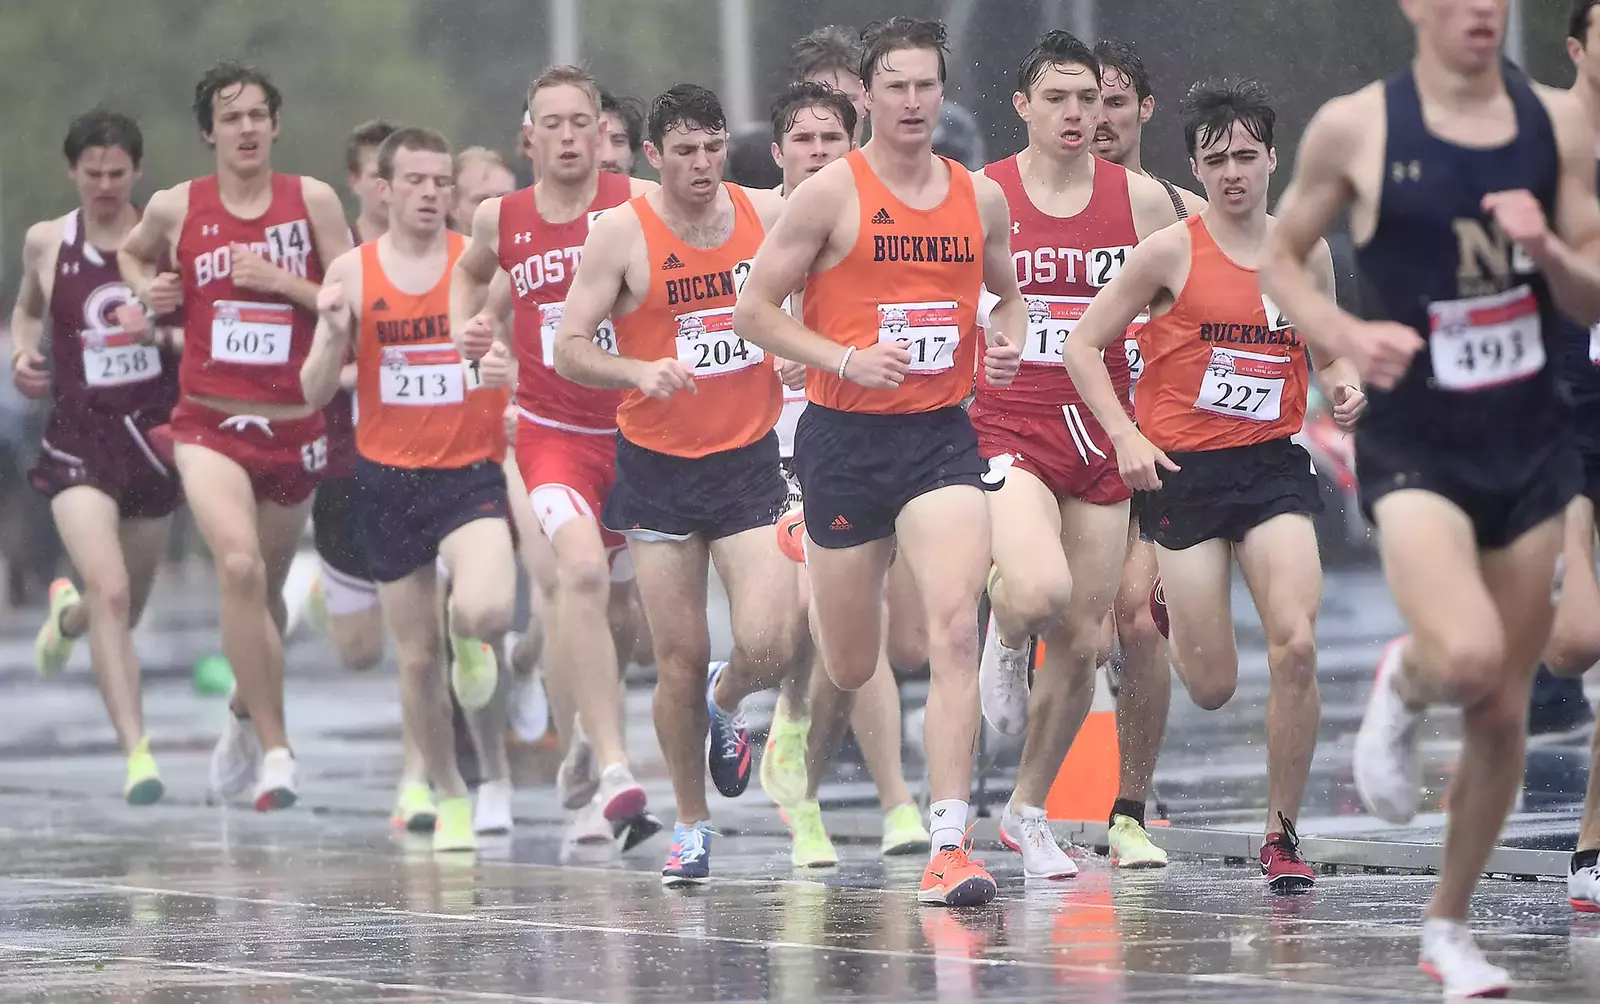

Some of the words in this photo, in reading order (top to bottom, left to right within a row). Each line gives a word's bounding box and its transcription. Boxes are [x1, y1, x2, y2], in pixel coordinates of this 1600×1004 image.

[270, 222, 305, 256] 14
[873, 235, 975, 263] BUCKNELL
[510, 245, 585, 298] BOST
[661, 261, 686, 271] adidas
[1011, 247, 1094, 289] OST
[666, 269, 735, 306] BUCKN
[226, 330, 276, 355] 605
[376, 313, 450, 344] BUCKNE
[1036, 328, 1070, 356] 13
[1200, 322, 1301, 348] BUCKNELL
[100, 349, 149, 378] 258
[693, 337, 749, 369] 204
[895, 335, 948, 363] 17
[394, 373, 448, 398] 213
[1211, 382, 1272, 413] 227
